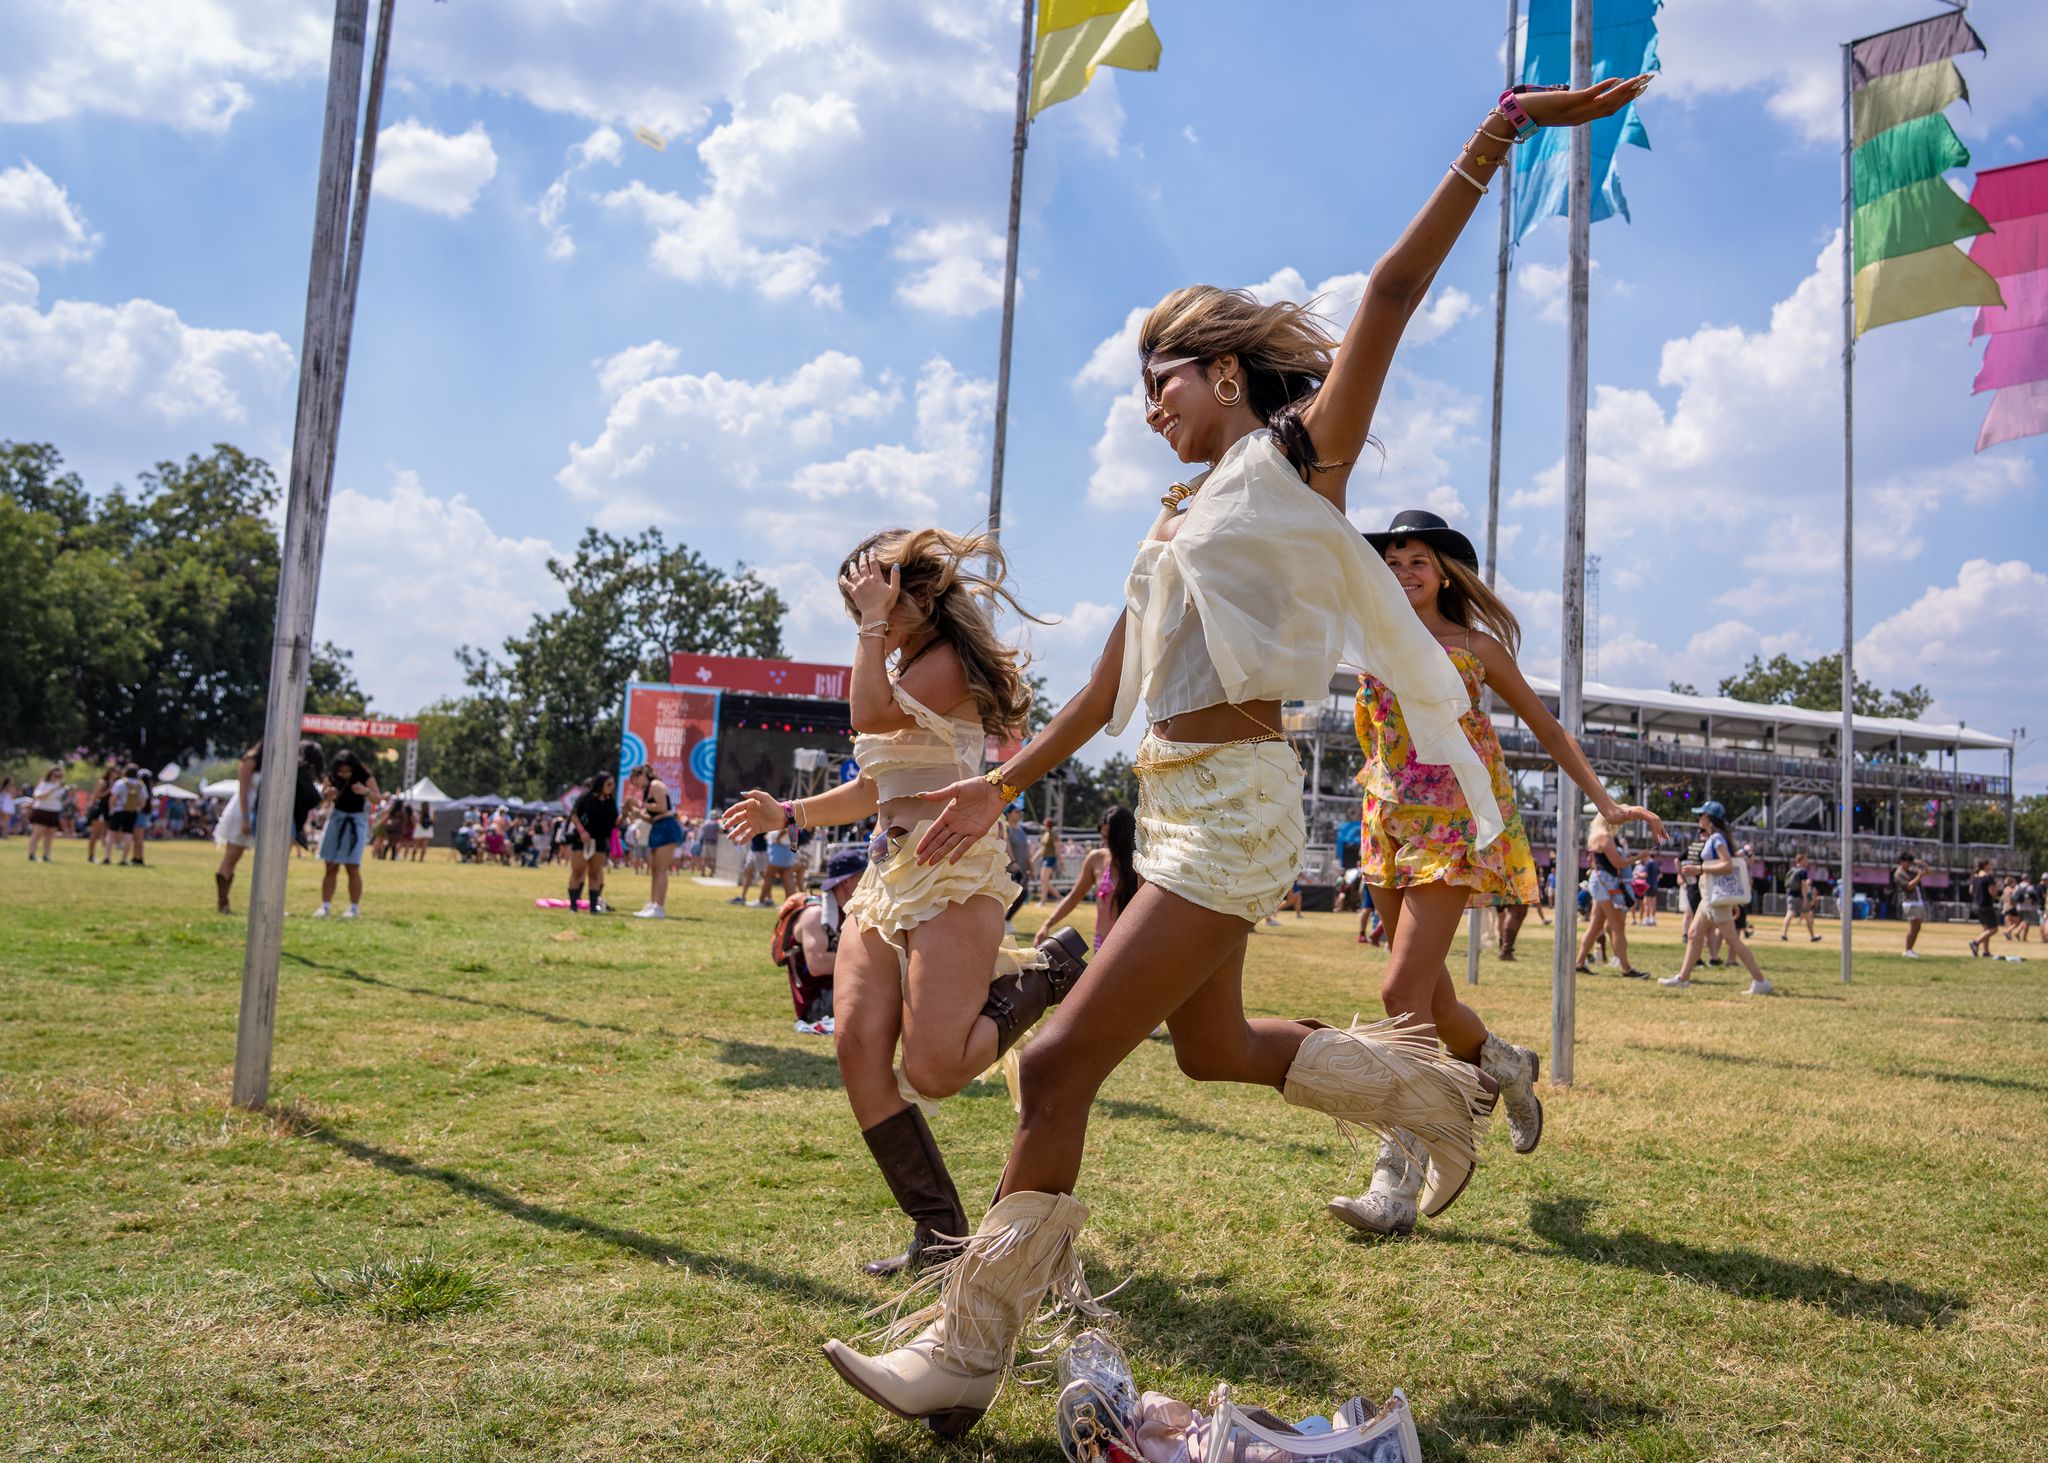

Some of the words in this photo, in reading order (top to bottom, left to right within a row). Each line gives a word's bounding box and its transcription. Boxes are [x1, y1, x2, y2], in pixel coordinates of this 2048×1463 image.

[303, 717, 369, 734] MERGENCY
[370, 723, 397, 736] EXIT
[654, 726, 686, 745] MUSIC
[656, 743, 682, 758] FEST
